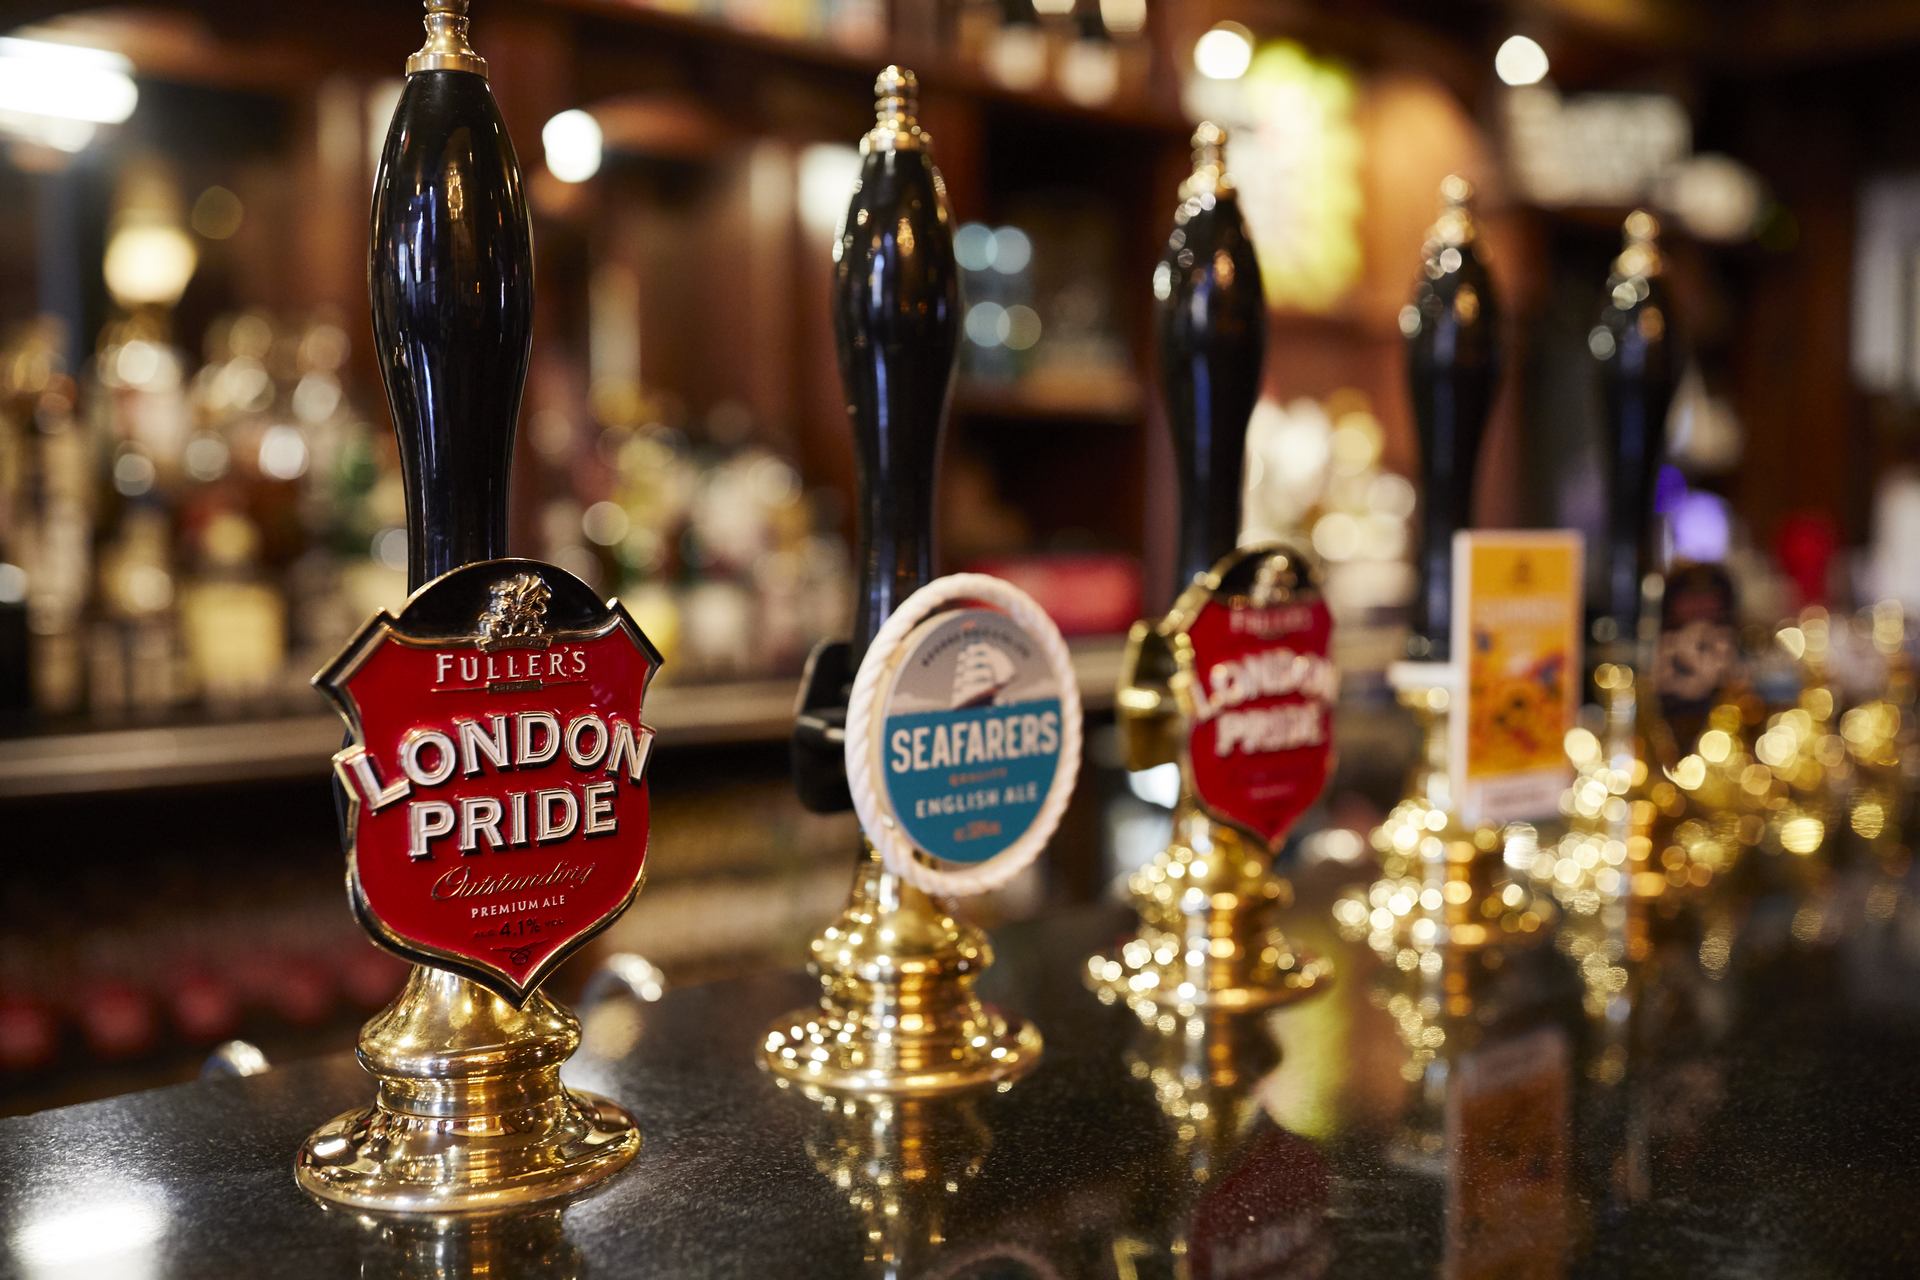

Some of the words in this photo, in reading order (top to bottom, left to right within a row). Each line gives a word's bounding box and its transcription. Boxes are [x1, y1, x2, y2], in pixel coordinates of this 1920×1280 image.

[434, 646, 587, 684] FULLER'S
[340, 710, 655, 815] LONDON
[891, 711, 1059, 774] SEAFARERS
[409, 780, 617, 860] PRIDE
[915, 789, 999, 819] ENGLISH
[1003, 782, 1038, 805] ALE
[430, 859, 596, 901] Outstanding
[471, 900, 539, 919] PREMIUM
[542, 895, 566, 908] ALE
[499, 918, 541, 938] 4.1%
